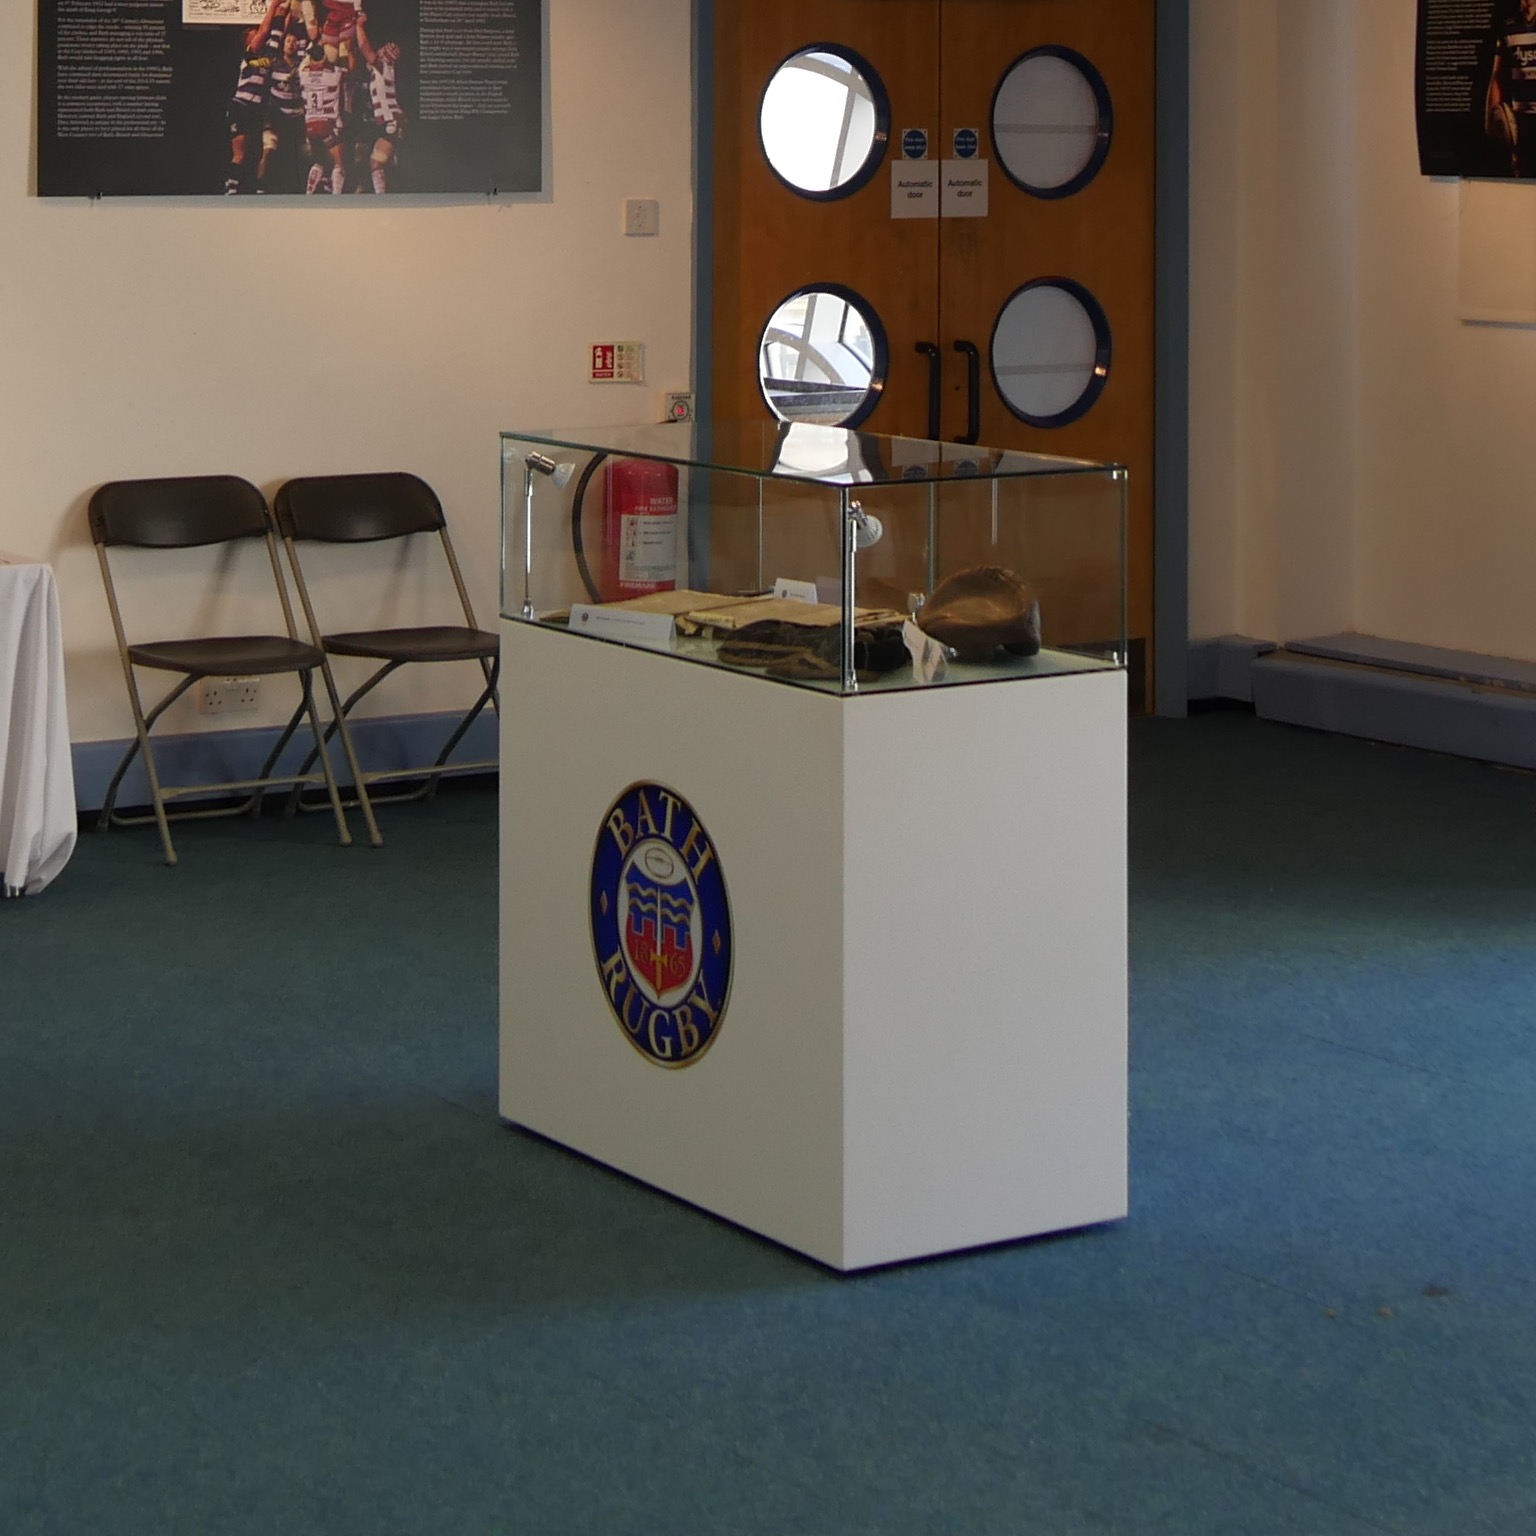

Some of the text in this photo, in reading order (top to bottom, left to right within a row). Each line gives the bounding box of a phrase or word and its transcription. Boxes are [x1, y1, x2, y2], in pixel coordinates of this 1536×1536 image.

[897, 180, 933, 189] Automatic
[947, 178, 983, 188] Automatic
[907, 191, 923, 199] door
[957, 190, 973, 198] door
[606, 788, 719, 885] BATH
[599, 944, 724, 1060] RUGBY
